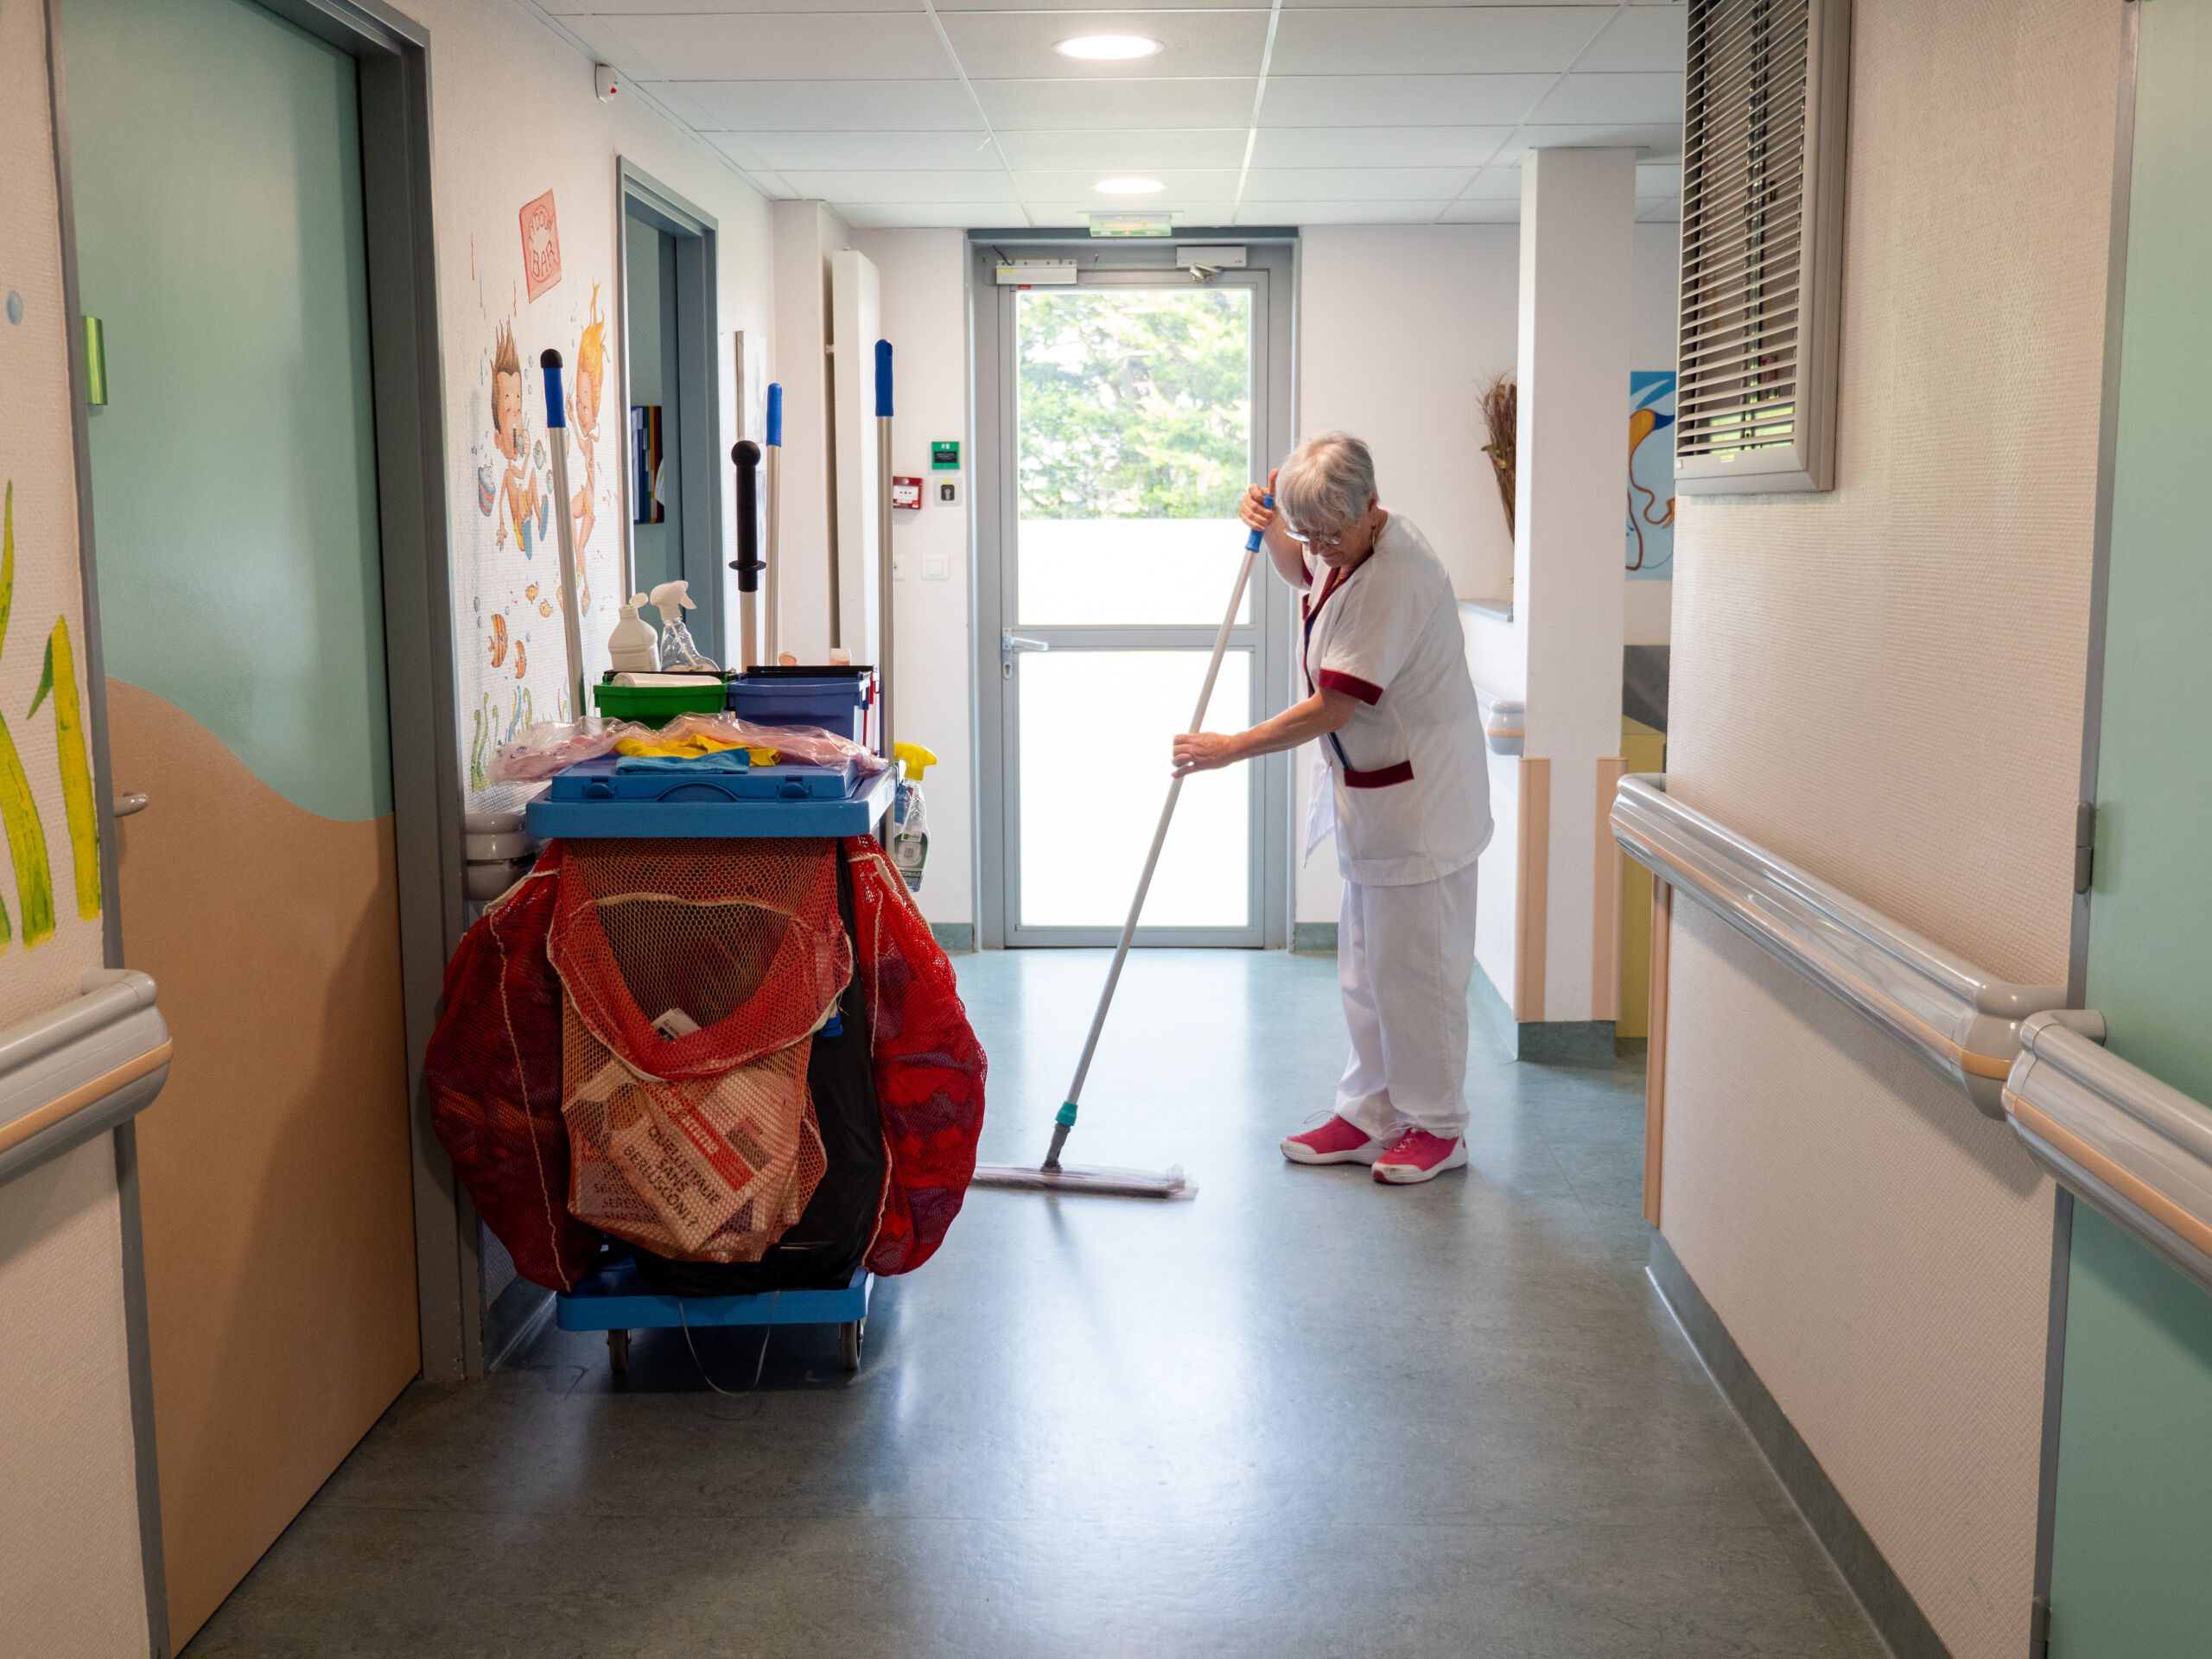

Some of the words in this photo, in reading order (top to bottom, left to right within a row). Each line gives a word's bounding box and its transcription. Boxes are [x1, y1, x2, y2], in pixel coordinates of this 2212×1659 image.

[532, 240, 555, 277] BAR
[620, 1144, 694, 1221] BERLUSCONI
[644, 1124, 693, 1174] QUELLE
[685, 1168, 722, 1206] ITALIE
[653, 1157, 690, 1194] SANS
